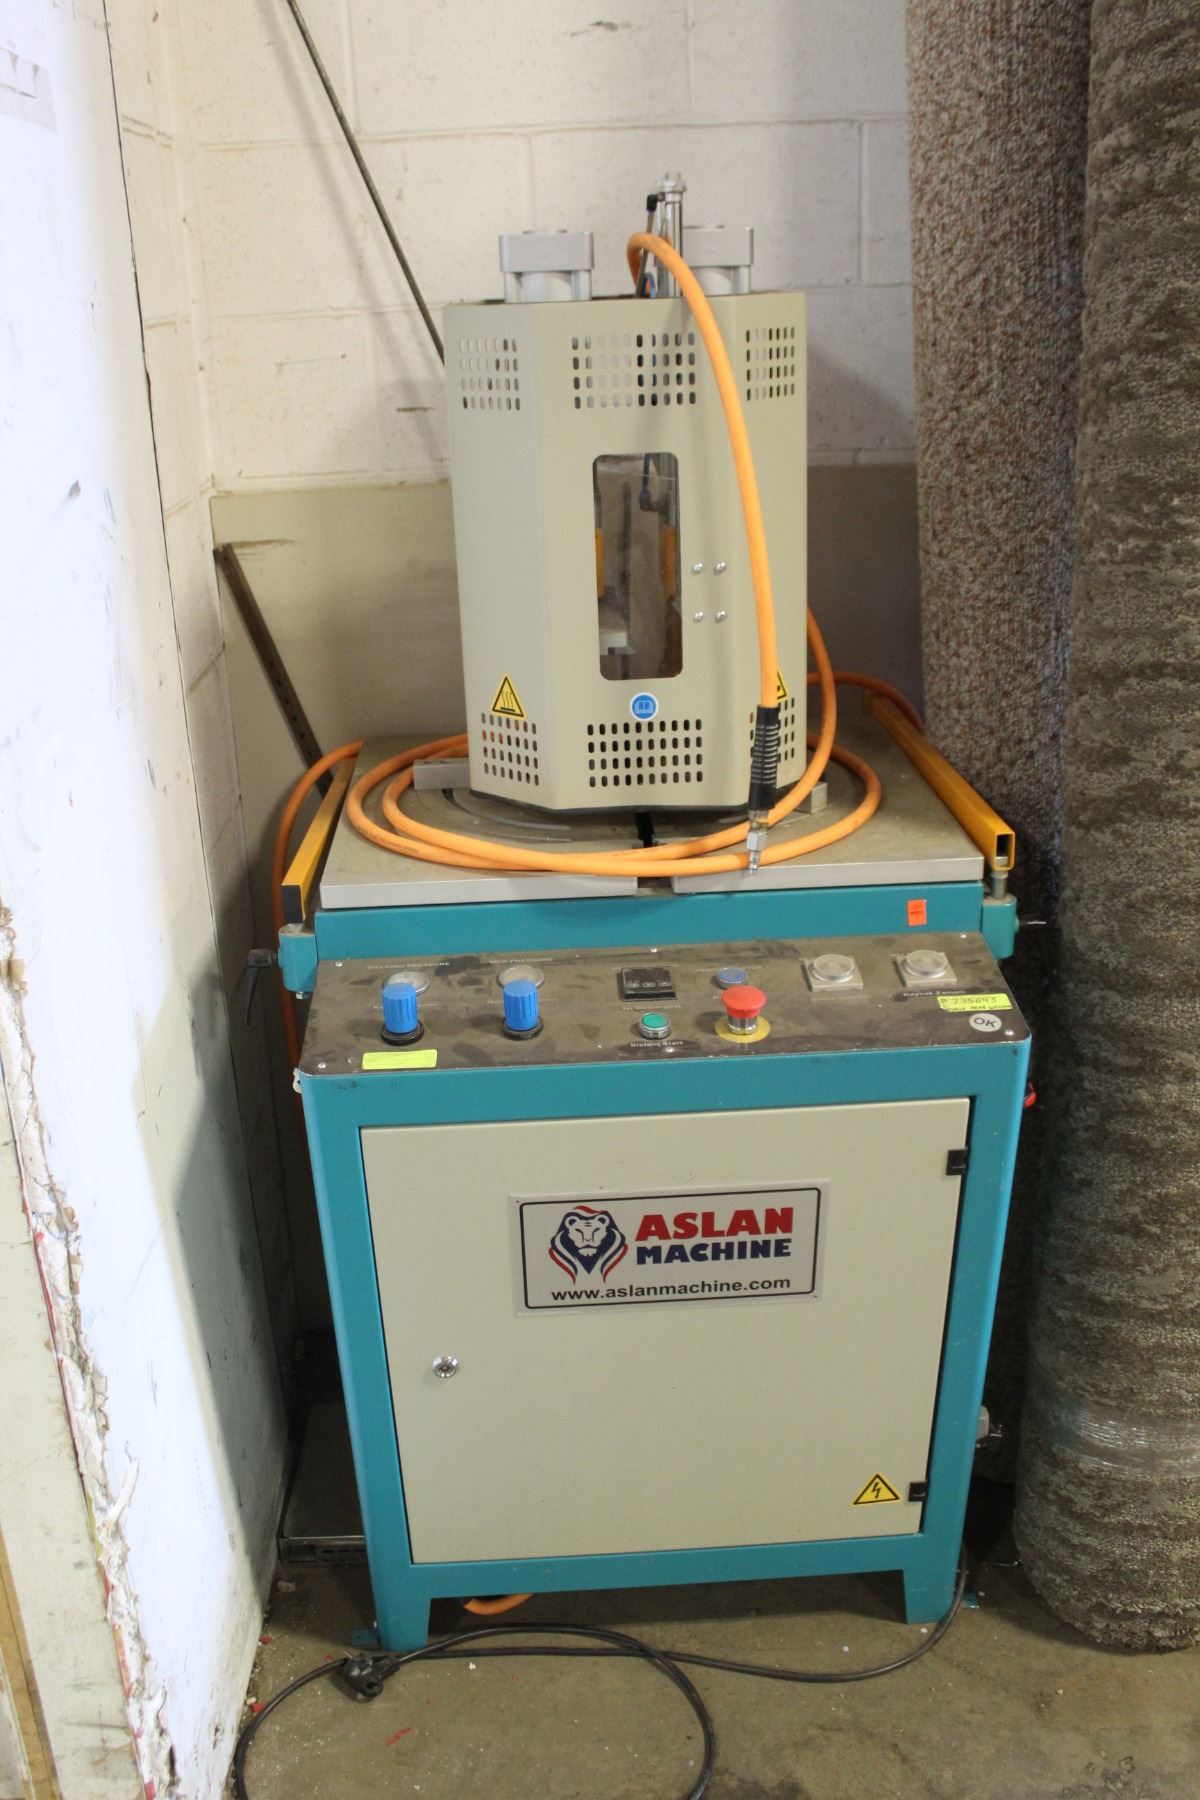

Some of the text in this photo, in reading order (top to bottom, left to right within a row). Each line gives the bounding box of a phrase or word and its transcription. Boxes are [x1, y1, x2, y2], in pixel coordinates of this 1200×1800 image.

[974, 1017, 997, 1028] OK
[635, 1207, 794, 1242] ASLAN
[636, 1238, 793, 1265] MACHINE
[551, 1276, 791, 1301] www.aslanmachine.com
